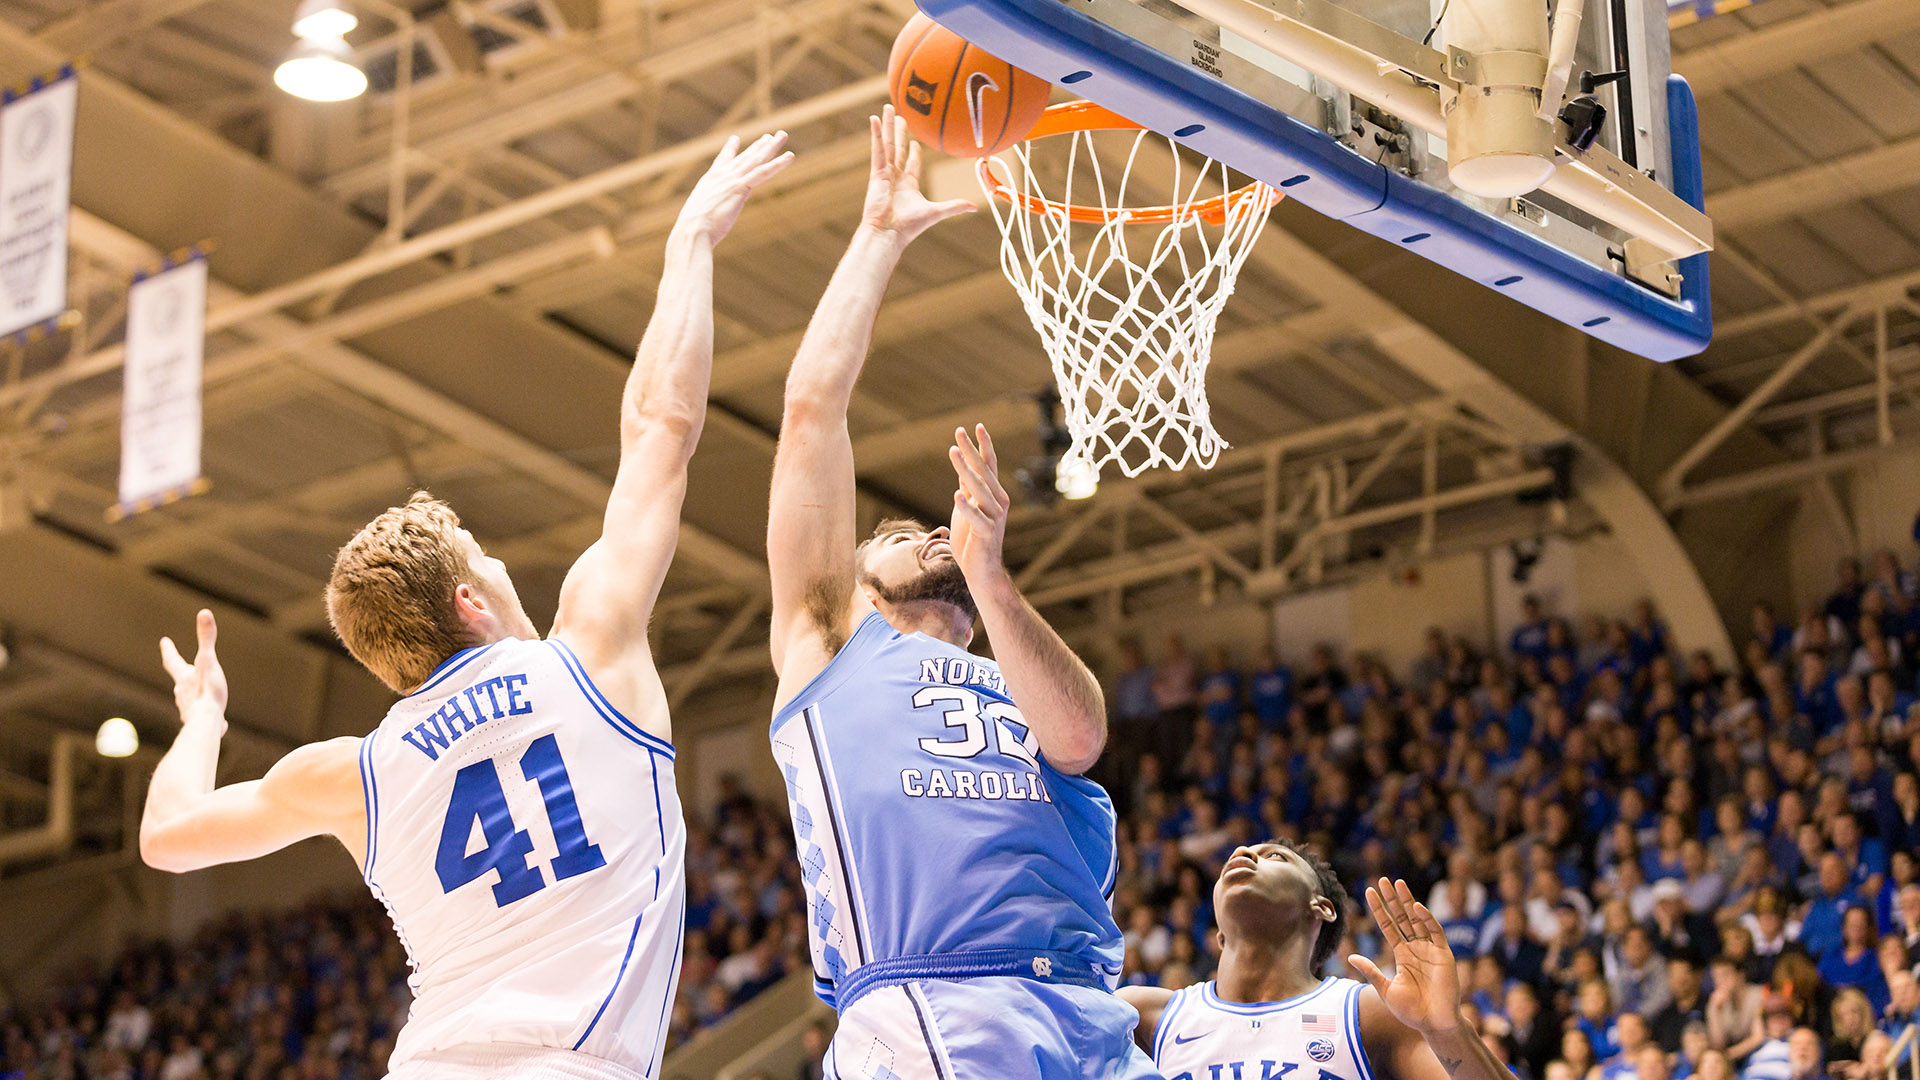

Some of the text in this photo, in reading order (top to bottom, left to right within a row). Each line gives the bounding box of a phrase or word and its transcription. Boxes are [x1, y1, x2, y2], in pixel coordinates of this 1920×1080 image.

[1193, 39, 1220, 58] GUARDIAN
[1198, 50, 1215, 66] GLASS
[1191, 56, 1223, 78] BACKBOARD
[919, 657, 1012, 699] NORT
[401, 673, 533, 761] WHITE
[434, 733, 607, 908] 41
